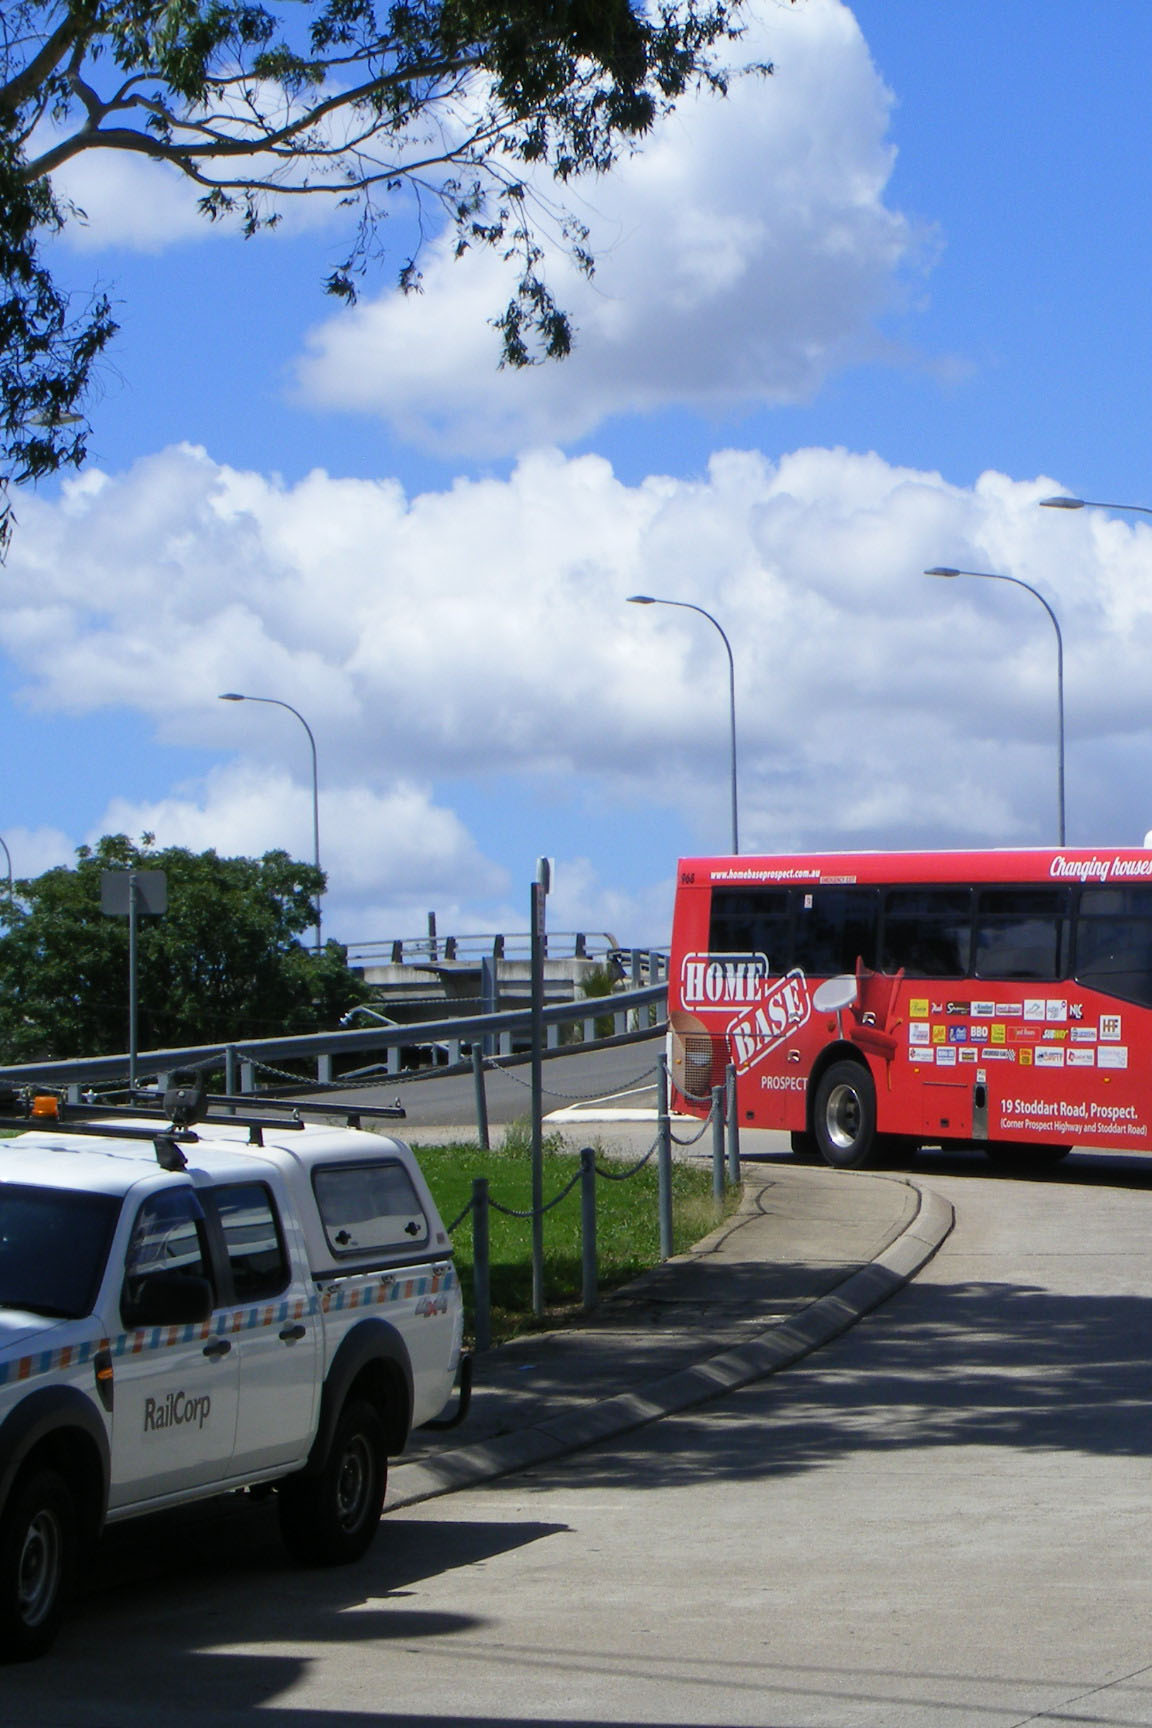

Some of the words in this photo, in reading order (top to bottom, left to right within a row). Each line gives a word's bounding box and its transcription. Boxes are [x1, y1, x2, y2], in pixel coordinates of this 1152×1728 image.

[682, 872, 695, 886] 968
[710, 868, 820, 881] www.homebaseprospect.com.au
[1050, 856, 1110, 882] Changing
[1111, 856, 1152, 876] houses
[686, 963, 763, 1001] HOME
[732, 979, 804, 1064] BASE
[761, 1075, 808, 1090] PROSPECT
[1001, 1099, 1013, 1113] 19
[1014, 1099, 1058, 1115] Stoddart
[1060, 1101, 1088, 1119] Road,
[1090, 1102, 1138, 1122] Prospect.
[1000, 1117, 1024, 1129] (Corner
[1025, 1118, 1053, 1132] Prospect
[1054, 1120, 1083, 1135] Highway
[1083, 1122, 1097, 1133] and
[1097, 1122, 1126, 1134] Stoddart
[1127, 1124, 1148, 1137] Road)
[144, 1391, 210, 1432] RailCorp
